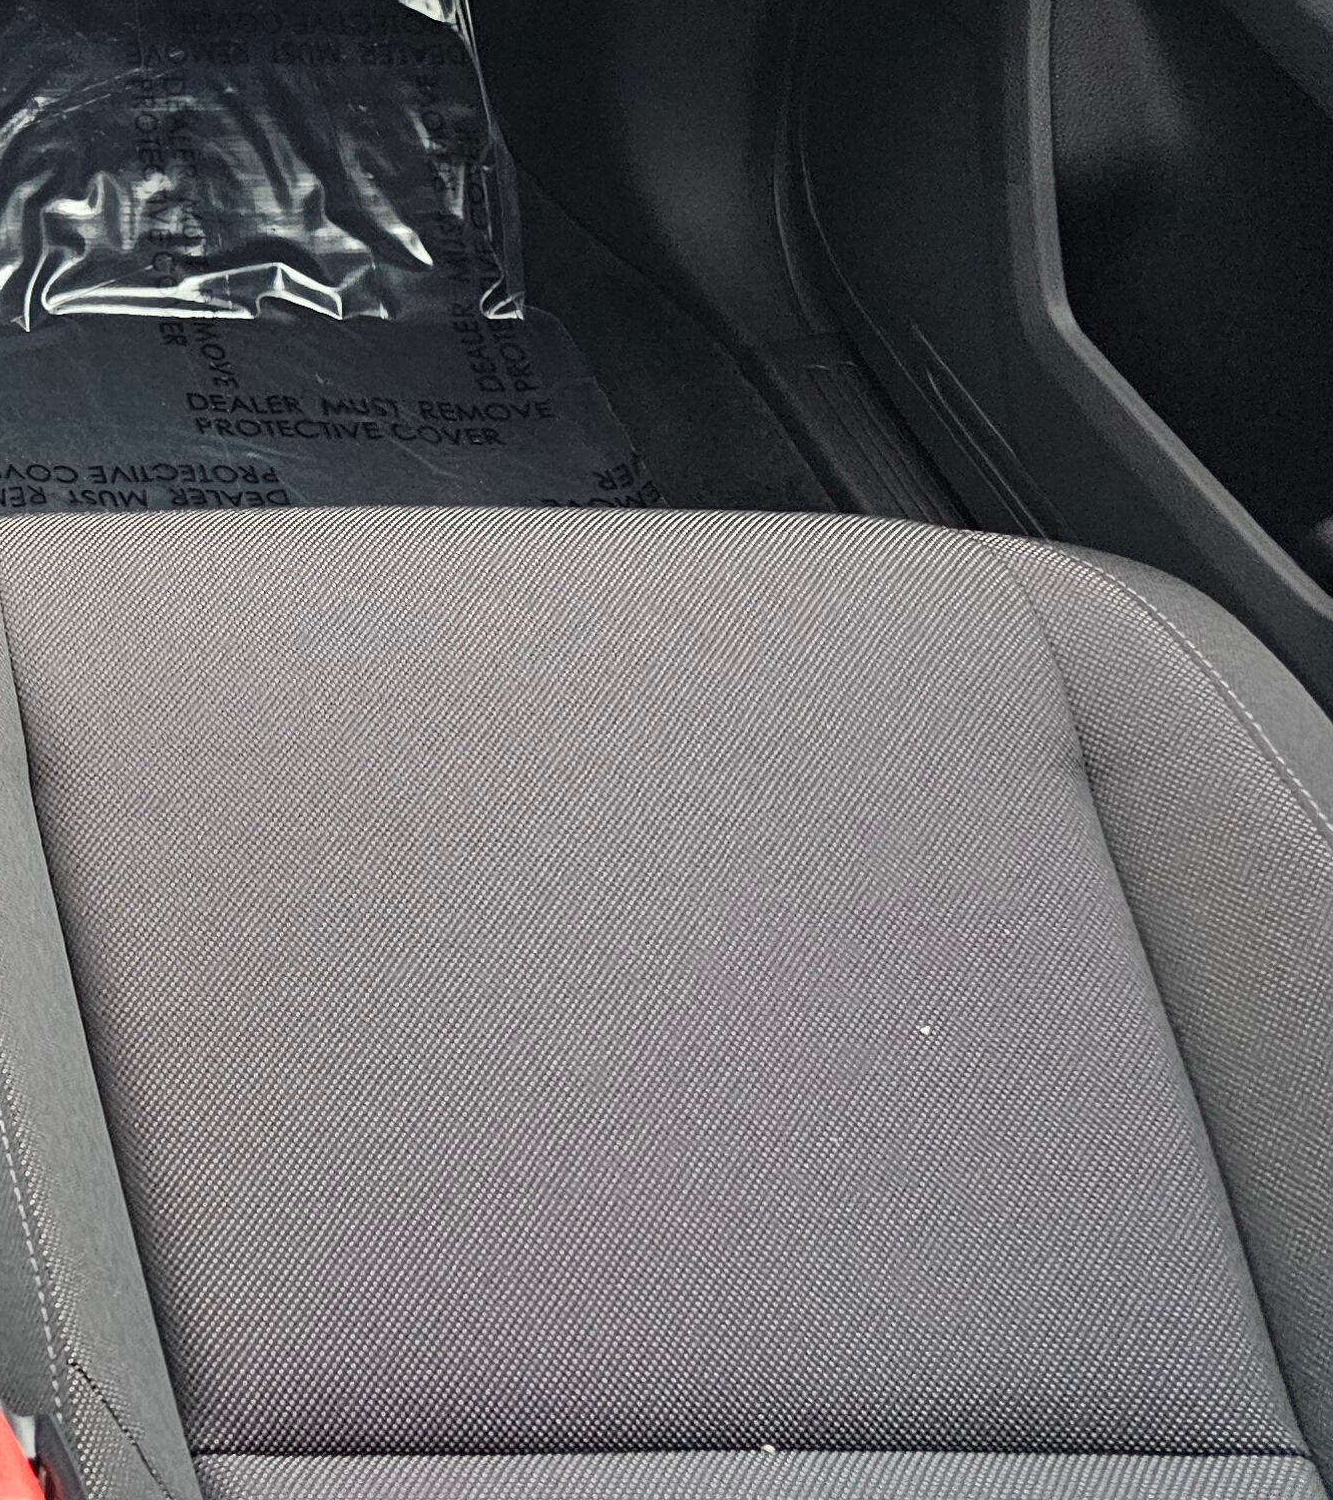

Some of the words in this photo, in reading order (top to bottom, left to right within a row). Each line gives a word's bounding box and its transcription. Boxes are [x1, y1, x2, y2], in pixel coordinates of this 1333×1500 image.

[184, 391, 305, 416] DEALER
[322, 396, 400, 418] MUST
[418, 398, 556, 423] REMOVE
[195, 416, 384, 440] PROTECTIVE
[389, 422, 508, 446] COVER
[89, 463, 281, 485] PROTECTIVE
